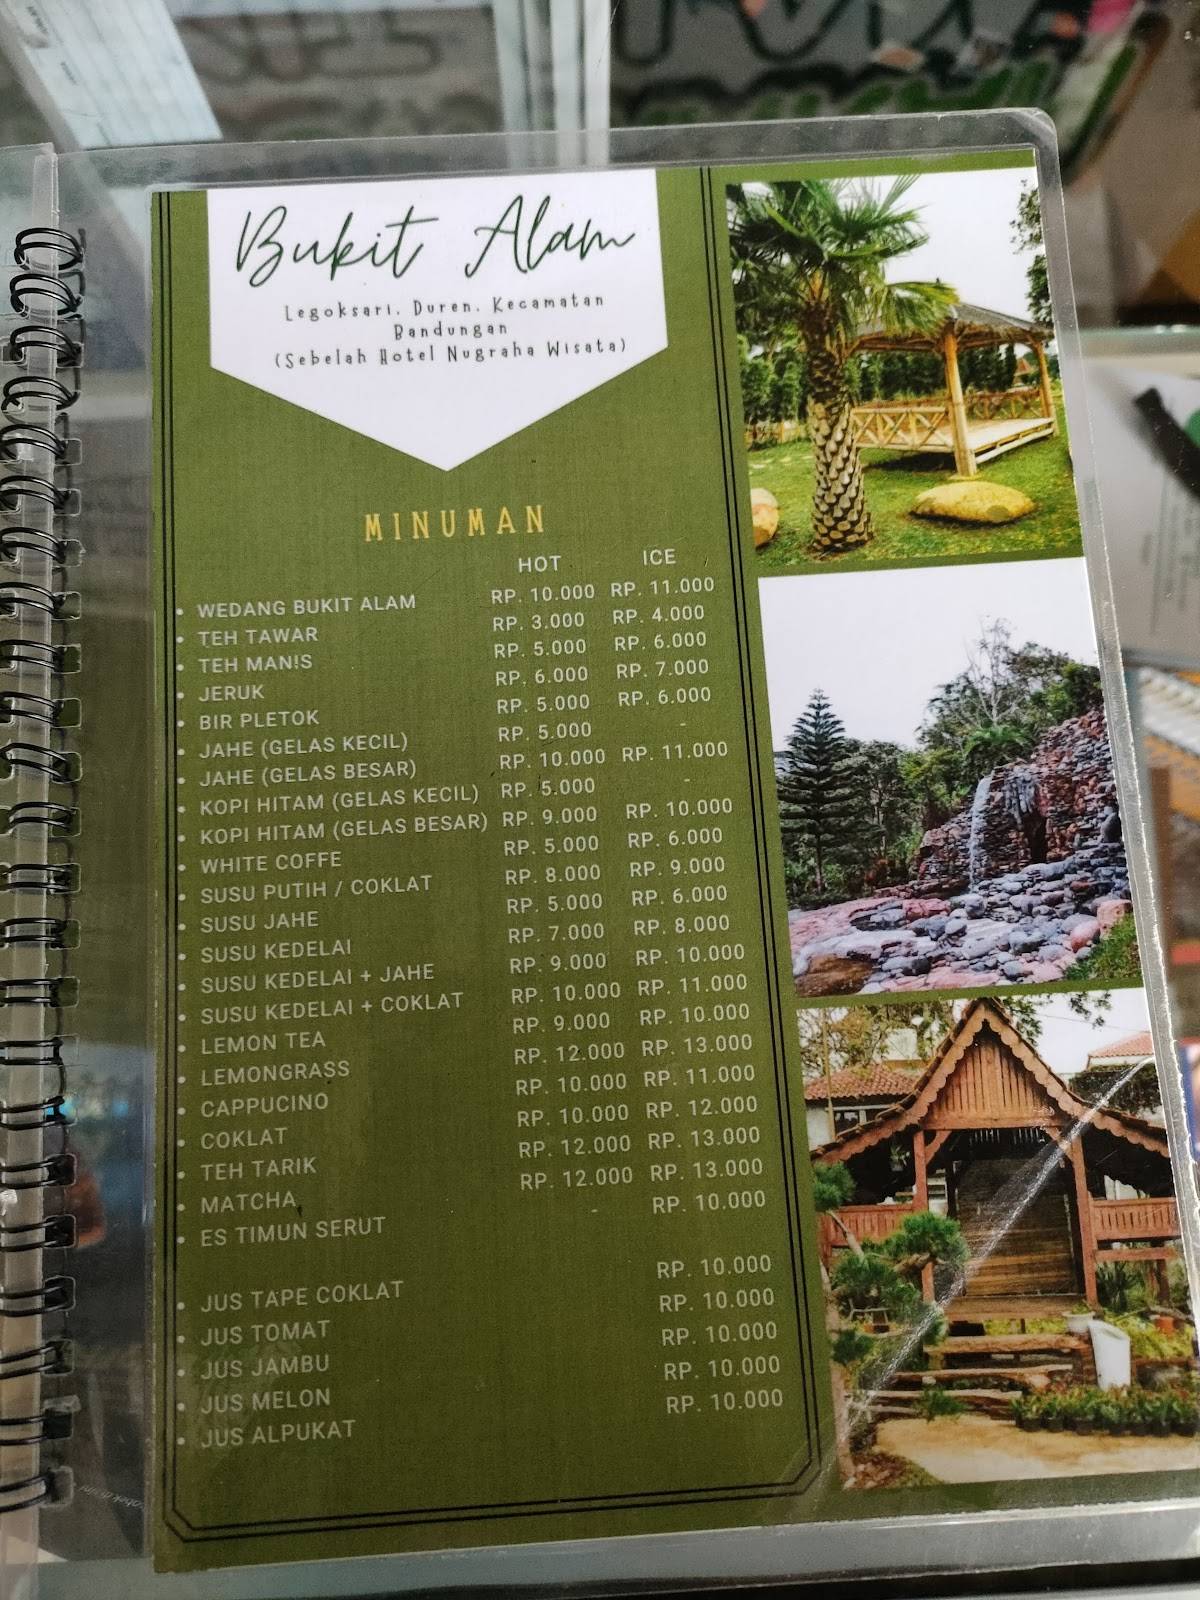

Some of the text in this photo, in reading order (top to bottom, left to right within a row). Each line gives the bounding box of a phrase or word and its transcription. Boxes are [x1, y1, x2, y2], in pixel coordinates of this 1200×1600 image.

[236, 195, 636, 287] Bukit Alam
[492, 293, 604, 313] Kecamatan
[393, 322, 508, 341] Bandungan
[275, 337, 627, 369] (Sebelah Hotel Nugraha Wisata)
[364, 504, 546, 542] MINUMAN
[519, 549, 675, 572] HOT ICE
[492, 584, 594, 604] RP. 10.000
[611, 577, 714, 597] RP. 11.000
[198, 595, 415, 618] WEDANG BUKIT ALAM
[613, 605, 704, 624] RP. 4.000
[198, 627, 318, 645] TEH TAWAR
[615, 632, 706, 651] RP. 6.000
[495, 639, 586, 658] RP. 5.000
[199, 654, 312, 673] TEH MANIS
[496, 666, 587, 686] RP. 6.000
[199, 685, 264, 701] JERUK
[497, 694, 589, 713] RP. 5.000
[619, 687, 710, 706] RP. 6.000
[200, 710, 319, 730] BIR PLETOK
[499, 722, 591, 741] RP. 5.000
[200, 733, 407, 759] JAHE (GELAS KECIL)
[500, 749, 605, 769] RP. 10.000
[200, 760, 416, 787] JAHE (GELAS BESAR)
[502, 778, 594, 798] RP. 5.000
[201, 785, 478, 815] KOPI HITAM (GELAS KECIL)
[627, 798, 732, 818] RP. 10.000
[503, 807, 596, 826] RP. 9.000
[201, 813, 487, 844] KOPI HITAM (GELAS BESAR)
[505, 836, 598, 855] RP. 5.000
[201, 852, 341, 873] WHITE COFFE
[630, 857, 724, 877] RP. 9.000
[506, 864, 600, 884] RP. 8.000
[202, 875, 431, 903] SUSU PUTIH COKLAT
[632, 885, 727, 906] RP. 6.000
[508, 893, 602, 913] RP. 5.000
[201, 911, 318, 932] SUSU JAHE
[634, 915, 729, 935] RP. 8.000
[202, 939, 350, 963] SUSU KEDELAI
[636, 944, 744, 965] RP. 10.000
[510, 953, 606, 973] RP. 9.000
[202, 964, 433, 993] SUSU KEDELAI JAHE
[512, 982, 620, 1003] RP. 10.000
[202, 992, 463, 1024] SUSU KEDELAI COKLAT
[640, 1003, 749, 1025] RP. 10.000
[513, 1012, 609, 1034] RP. 9.000
[202, 1031, 325, 1054] LEMON TEA
[515, 1042, 624, 1064] RP. 12.000
[642, 1034, 752, 1056] RP. 13.000
[202, 1061, 349, 1086] LEMONGRASS
[644, 1065, 754, 1086] RP. 11.000
[201, 1093, 328, 1117] CAPPUCINO
[518, 1104, 628, 1127] RP. 10.000
[647, 1096, 757, 1118] RP. 12.000
[201, 1127, 287, 1149] COKLAT
[519, 1135, 630, 1158] RP. 12.000
[201, 1157, 316, 1180] TEH TARIK
[521, 1167, 632, 1190] RP. 12.000
[651, 1158, 762, 1181] RP. 13.000
[202, 1191, 296, 1213] MATCHA
[653, 1190, 765, 1213] RP. 10.000
[202, 1217, 385, 1246] ES TIMUN SERUT
[657, 1255, 771, 1278] RP. 10.000
[201, 1281, 403, 1312] JUS TAPE COKLAT
[660, 1288, 774, 1312] RP. 10.000
[201, 1320, 330, 1346] JUS TOMAT
[662, 1321, 777, 1346] RP. 10.000
[201, 1354, 328, 1379] JUS JAMBU
[665, 1355, 779, 1380] RP. 10.000
[201, 1388, 330, 1414] JUS MELON
[667, 1389, 782, 1413] RP. 10.000
[201, 1420, 355, 1448] JUS ALPUKAT
